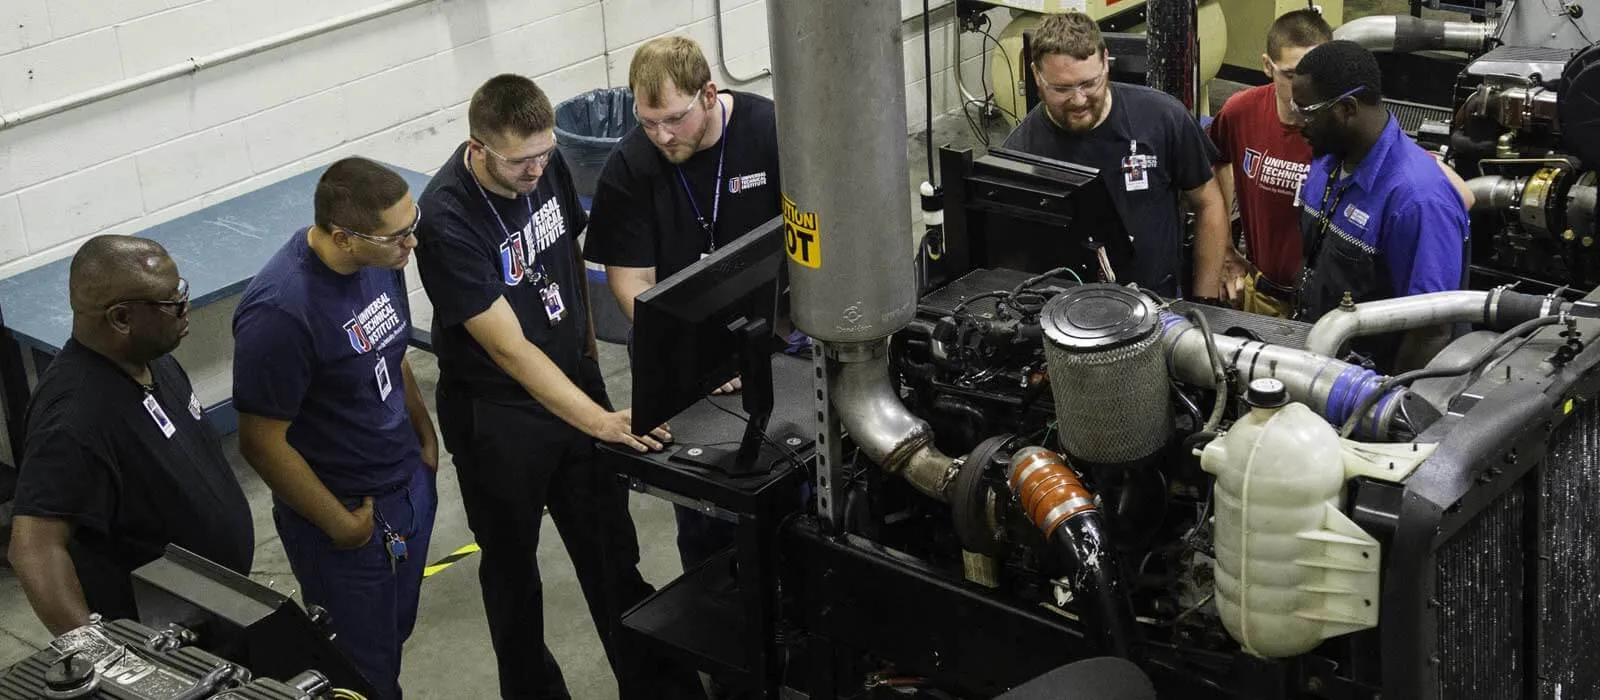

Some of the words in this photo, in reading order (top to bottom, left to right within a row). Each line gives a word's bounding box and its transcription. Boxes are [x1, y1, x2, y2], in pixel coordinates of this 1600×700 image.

[1264, 156, 1311, 173] UNIVERSA
[1262, 165, 1301, 181] TECHNIC
[1260, 174, 1298, 190] INSTITU
[786, 223, 814, 262] OT
